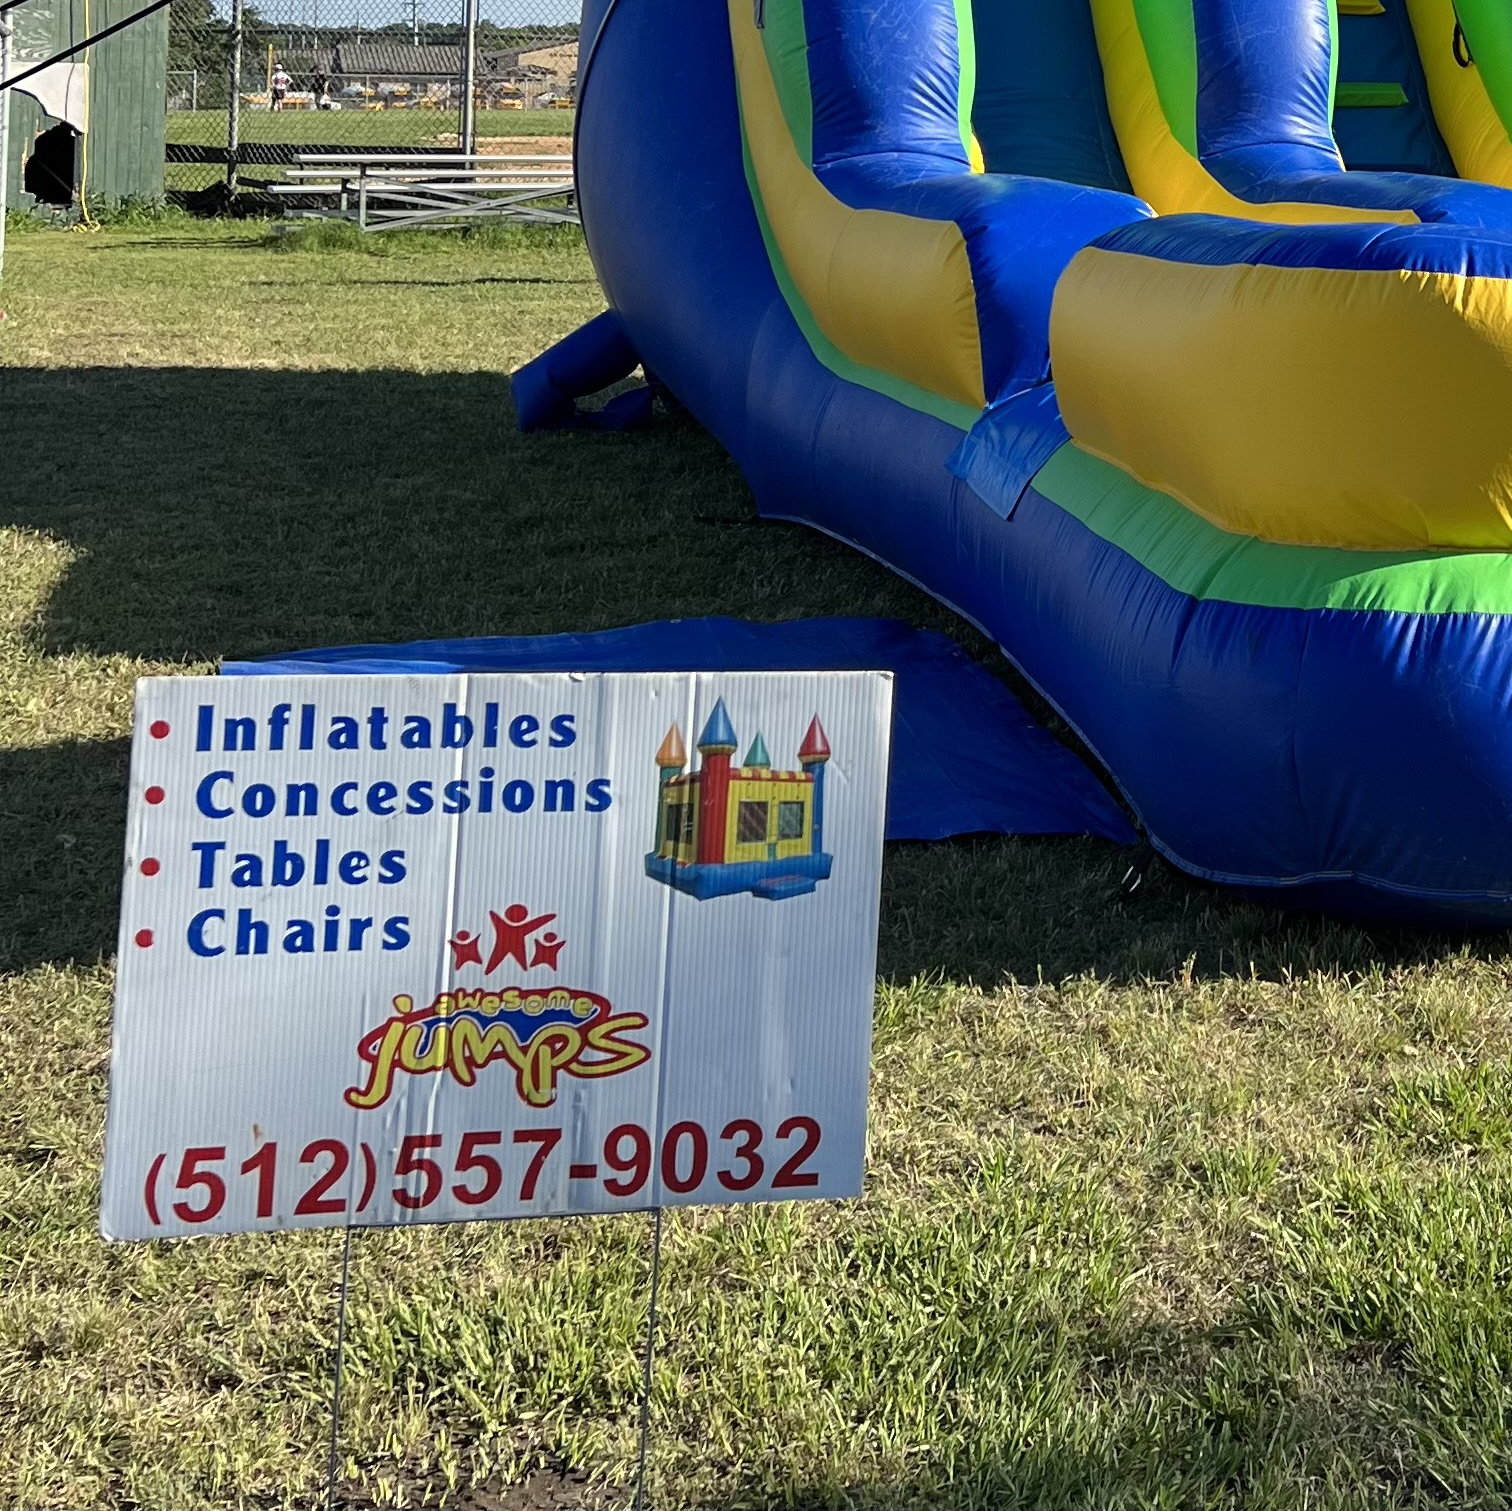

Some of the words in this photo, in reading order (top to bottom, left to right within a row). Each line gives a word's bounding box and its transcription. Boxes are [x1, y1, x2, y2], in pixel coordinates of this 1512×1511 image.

[195, 702, 578, 752] Inflatables
[195, 766, 613, 819] Concessions
[191, 838, 407, 889] Tables
[186, 904, 411, 958] Chairs
[144, 1115, 822, 1226] (512)557-9032
